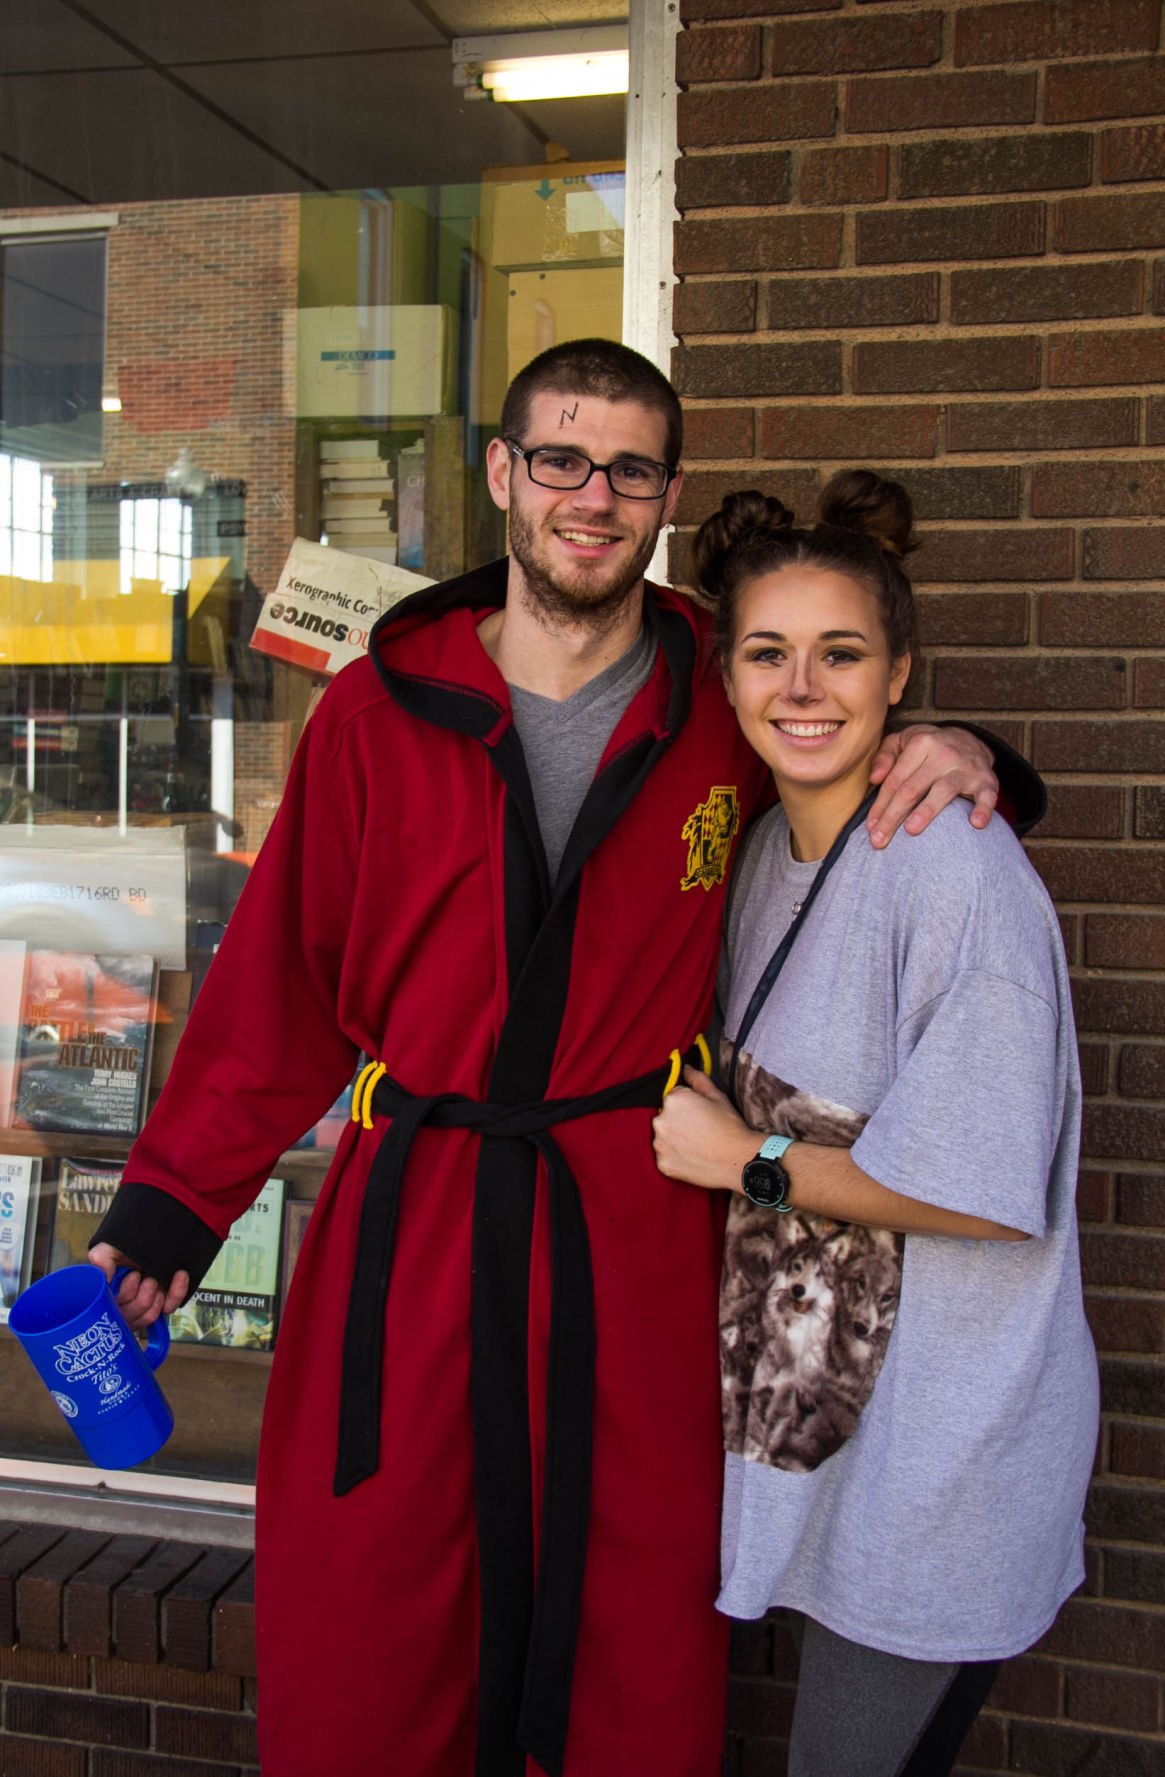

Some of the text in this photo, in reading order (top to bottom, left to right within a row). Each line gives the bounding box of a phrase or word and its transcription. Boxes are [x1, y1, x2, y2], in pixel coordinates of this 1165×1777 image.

[57, 1044, 139, 1072] ATLANTIC
[224, 1294, 235, 1305] IN
[236, 1296, 265, 1308] DEATH
[53, 1312, 113, 1358] NEON
[55, 1321, 122, 1375] CACTUS
